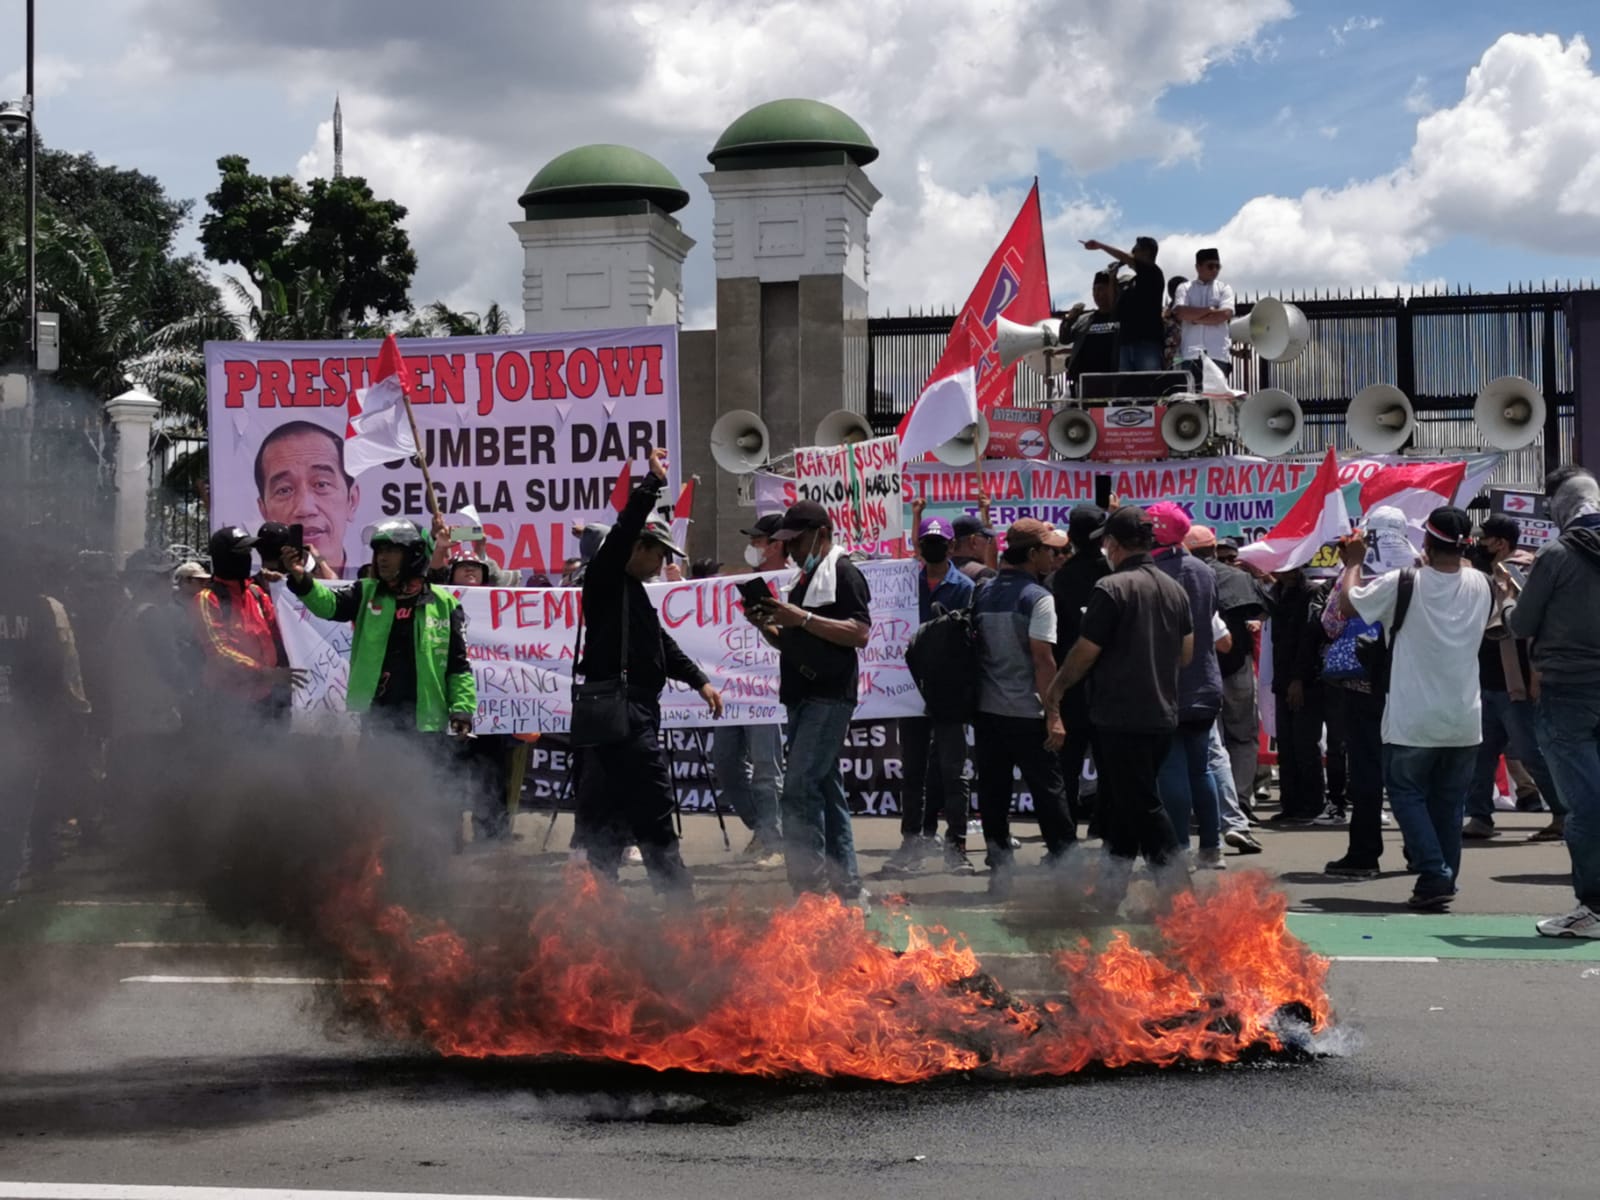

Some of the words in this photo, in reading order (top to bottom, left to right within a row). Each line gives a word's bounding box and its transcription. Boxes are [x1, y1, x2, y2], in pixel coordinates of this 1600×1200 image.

[225, 353, 466, 408] PRESIEN
[475, 344, 664, 416] JOKOWI
[571, 420, 667, 464] DARI
[854, 439, 898, 472] SUSAH
[382, 480, 515, 516] SEGALA
[865, 474, 900, 498] HARUS
[902, 470, 1025, 503] STIMEWA
[1032, 467, 1198, 500] MAHAMAH
[1207, 463, 1307, 497] RAKYAT
[964, 506, 1071, 525] TERBUK
[1205, 499, 1274, 522] UMUM
[515, 643, 552, 661] HAK
[477, 699, 553, 718] ORENSIK
